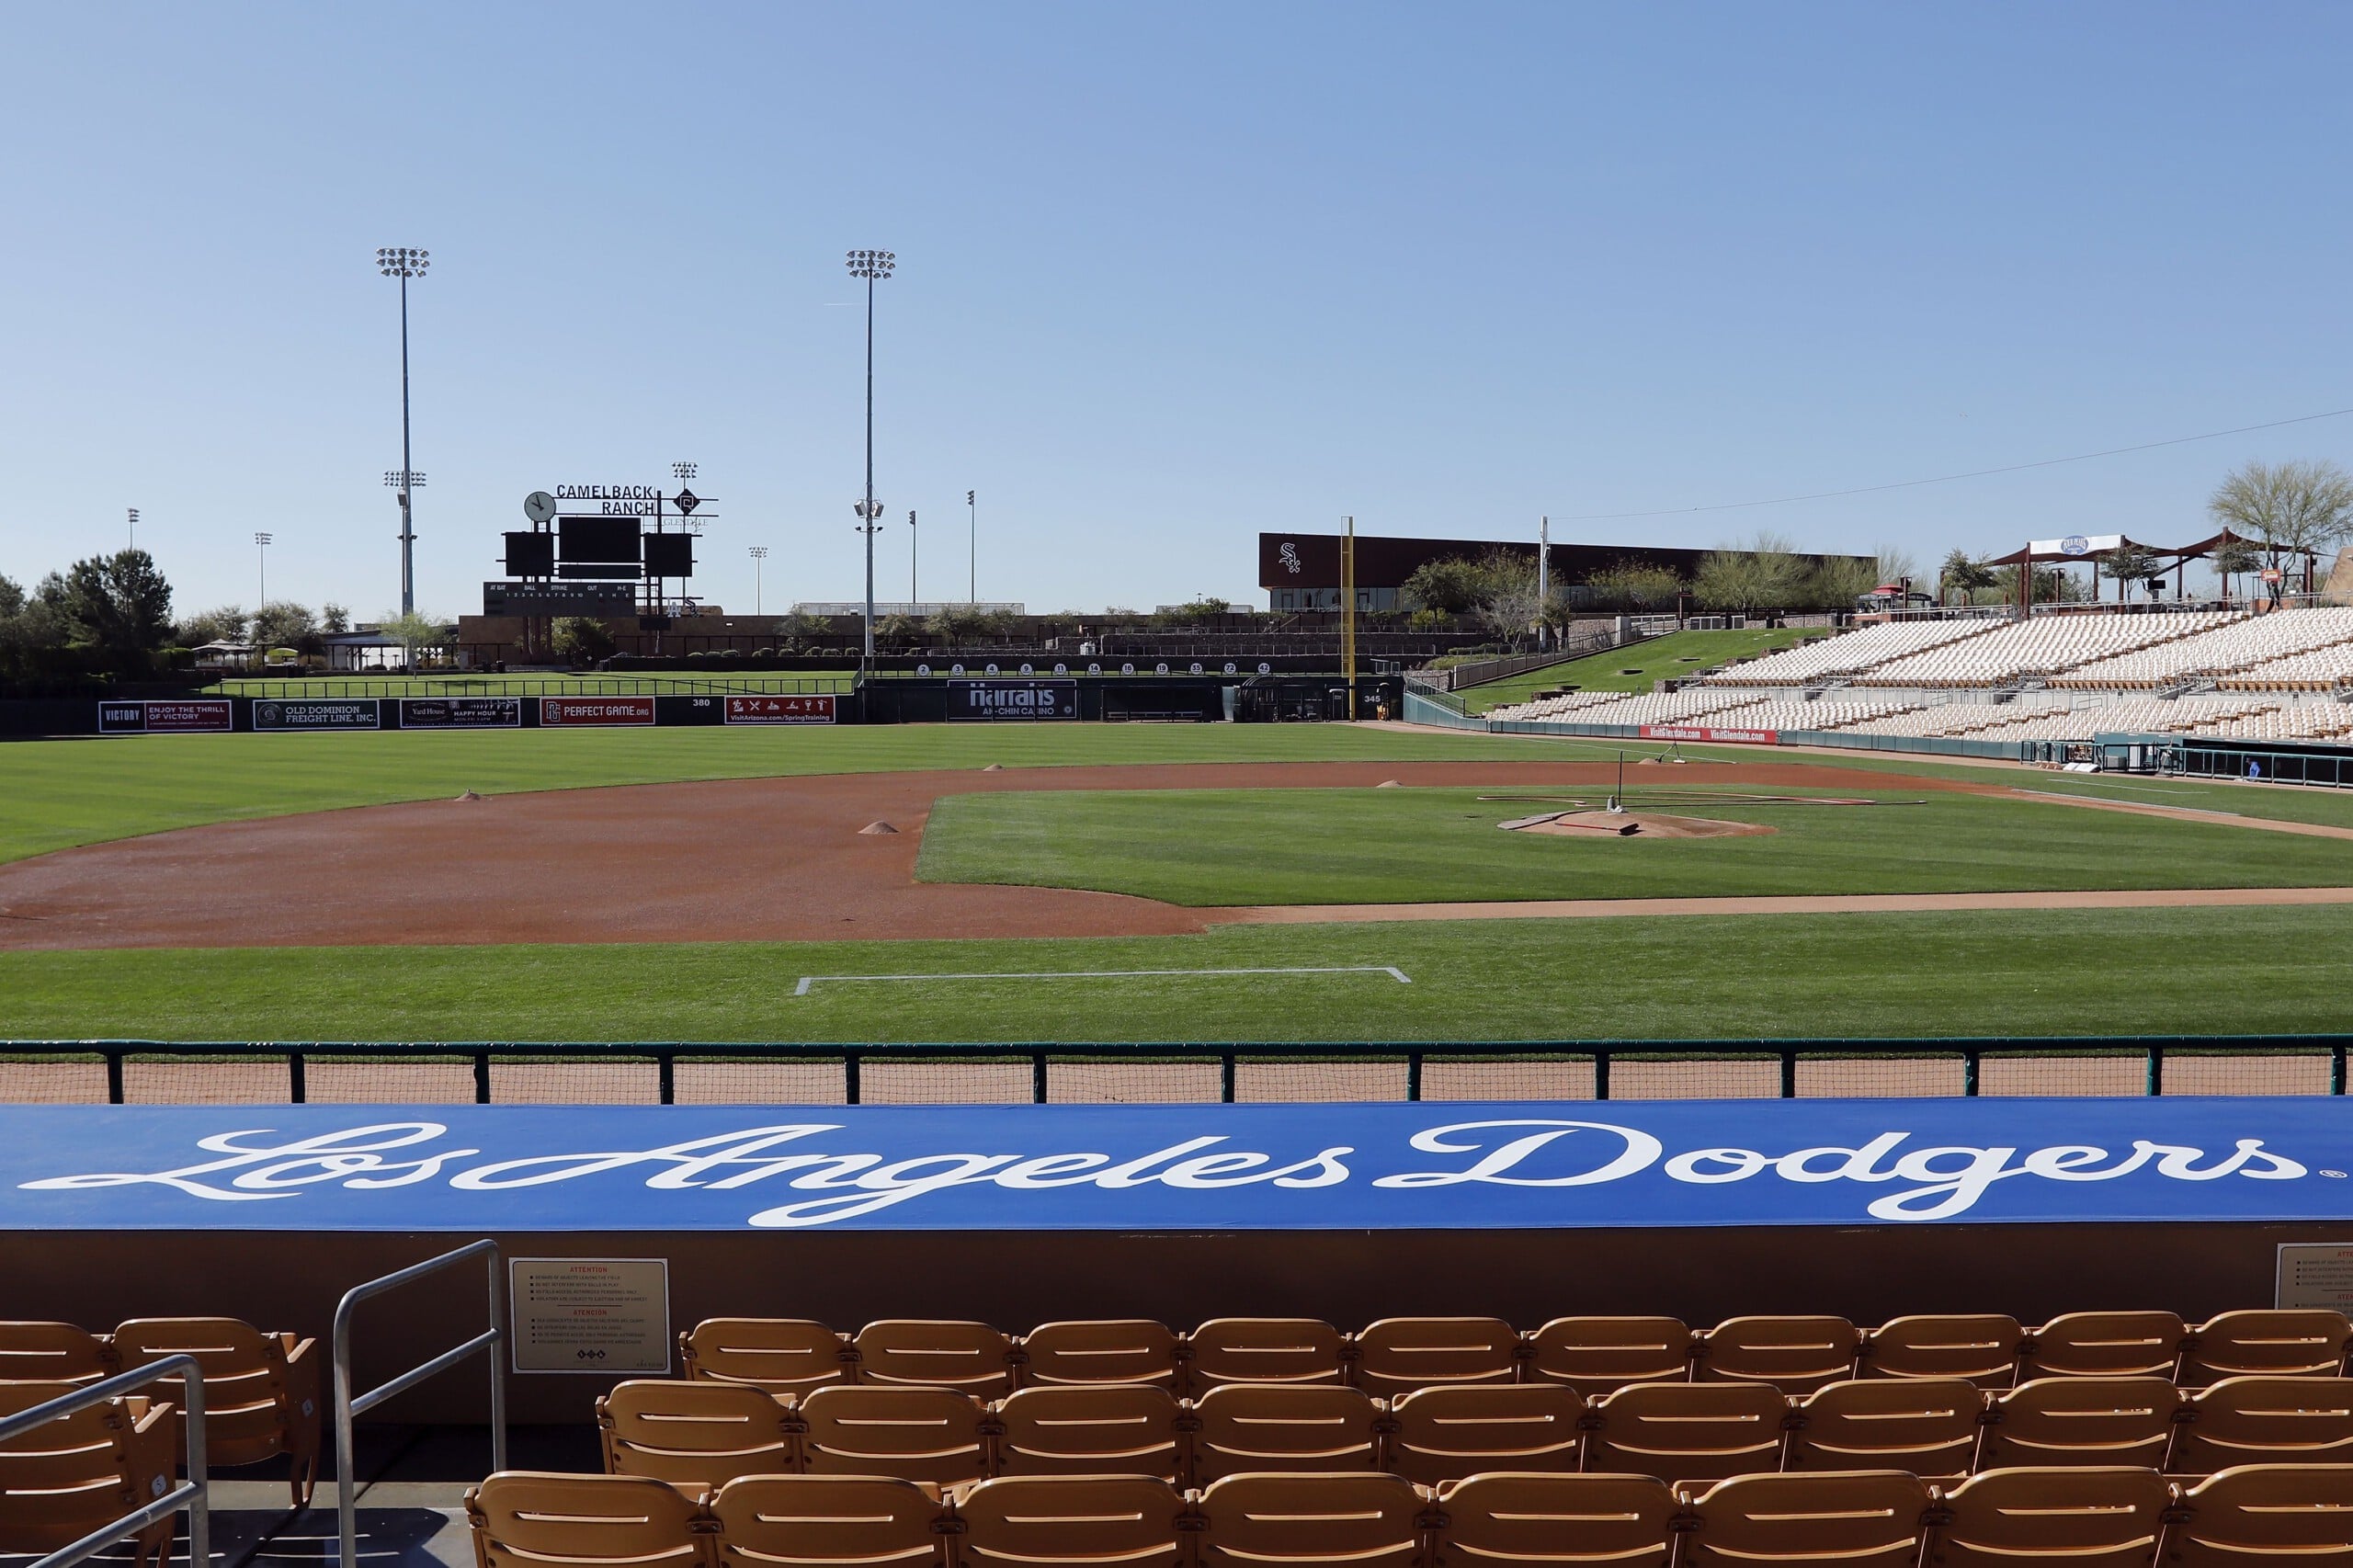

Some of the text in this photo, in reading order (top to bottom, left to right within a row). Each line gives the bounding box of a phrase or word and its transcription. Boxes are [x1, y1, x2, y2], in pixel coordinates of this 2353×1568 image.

[557, 484, 654, 499] CAMELBACK
[602, 501, 654, 515] RANCH
[105, 710, 140, 721] VICTORY
[309, 706, 360, 714] DOMINION
[564, 706, 604, 717] PERFECT
[286, 715, 328, 723] FREIGHT
[356, 714, 376, 722] INC.
[1650, 727, 1700, 739] VisitGlendale.com
[1710, 729, 1765, 741] VisitGlendale.com
[17, 1119, 2308, 1228] Los Angeles Dodgers
